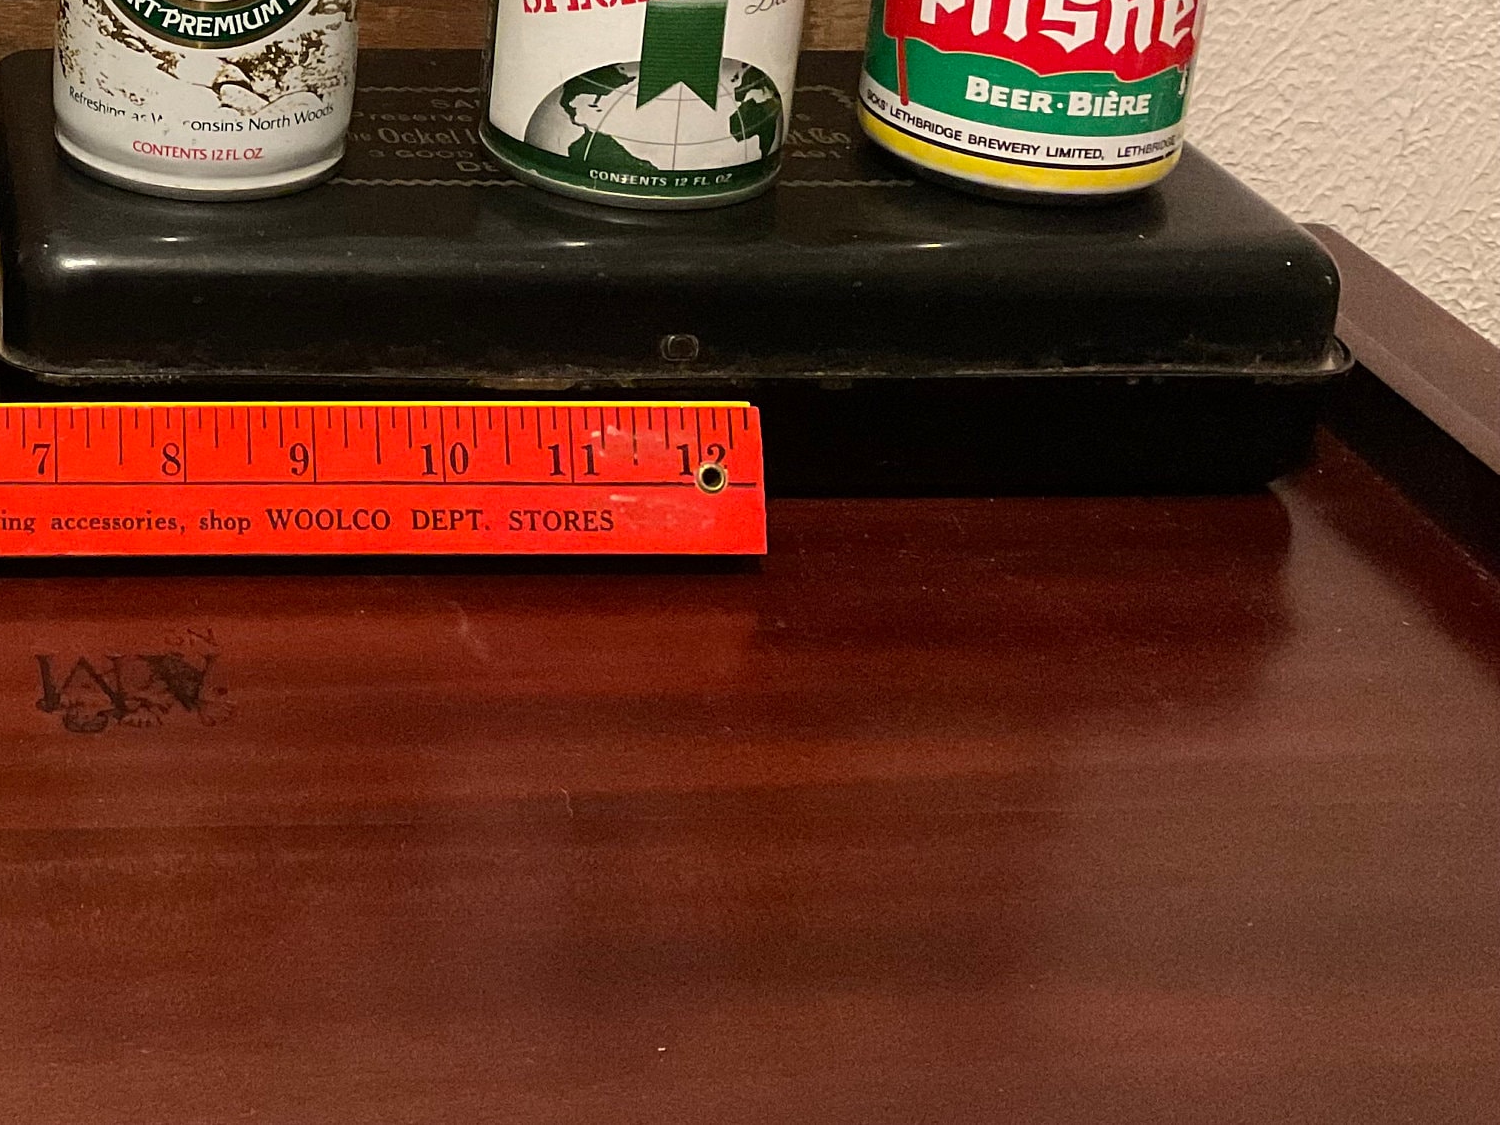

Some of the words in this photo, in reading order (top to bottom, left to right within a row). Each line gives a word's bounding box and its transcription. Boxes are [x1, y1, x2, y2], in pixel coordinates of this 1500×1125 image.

[248, 115, 291, 131] North
[293, 101, 335, 125] Woods
[890, 105, 963, 142] LETHBRIDGE
[968, 133, 1041, 156] BREWERY
[1046, 145, 1105, 161] LIMITED,
[132, 140, 207, 161] CONTENTS
[211, 148, 225, 161] 12
[226, 148, 241, 161] FL
[243, 147, 264, 161] OZ
[589, 169, 667, 187] CONTENTS
[674, 178, 688, 187] 12
[31, 443, 51, 475] 7
[161, 442, 181, 476] 8
[289, 443, 310, 476] 9
[421, 442, 470, 476] 10
[549, 443, 600, 476] 11
[50, 510, 186, 534] accessories,
[199, 509, 252, 535] shop
[265, 509, 391, 531] WOOLCO
[412, 508, 491, 532] DEPT.
[508, 508, 614, 532] STORES
